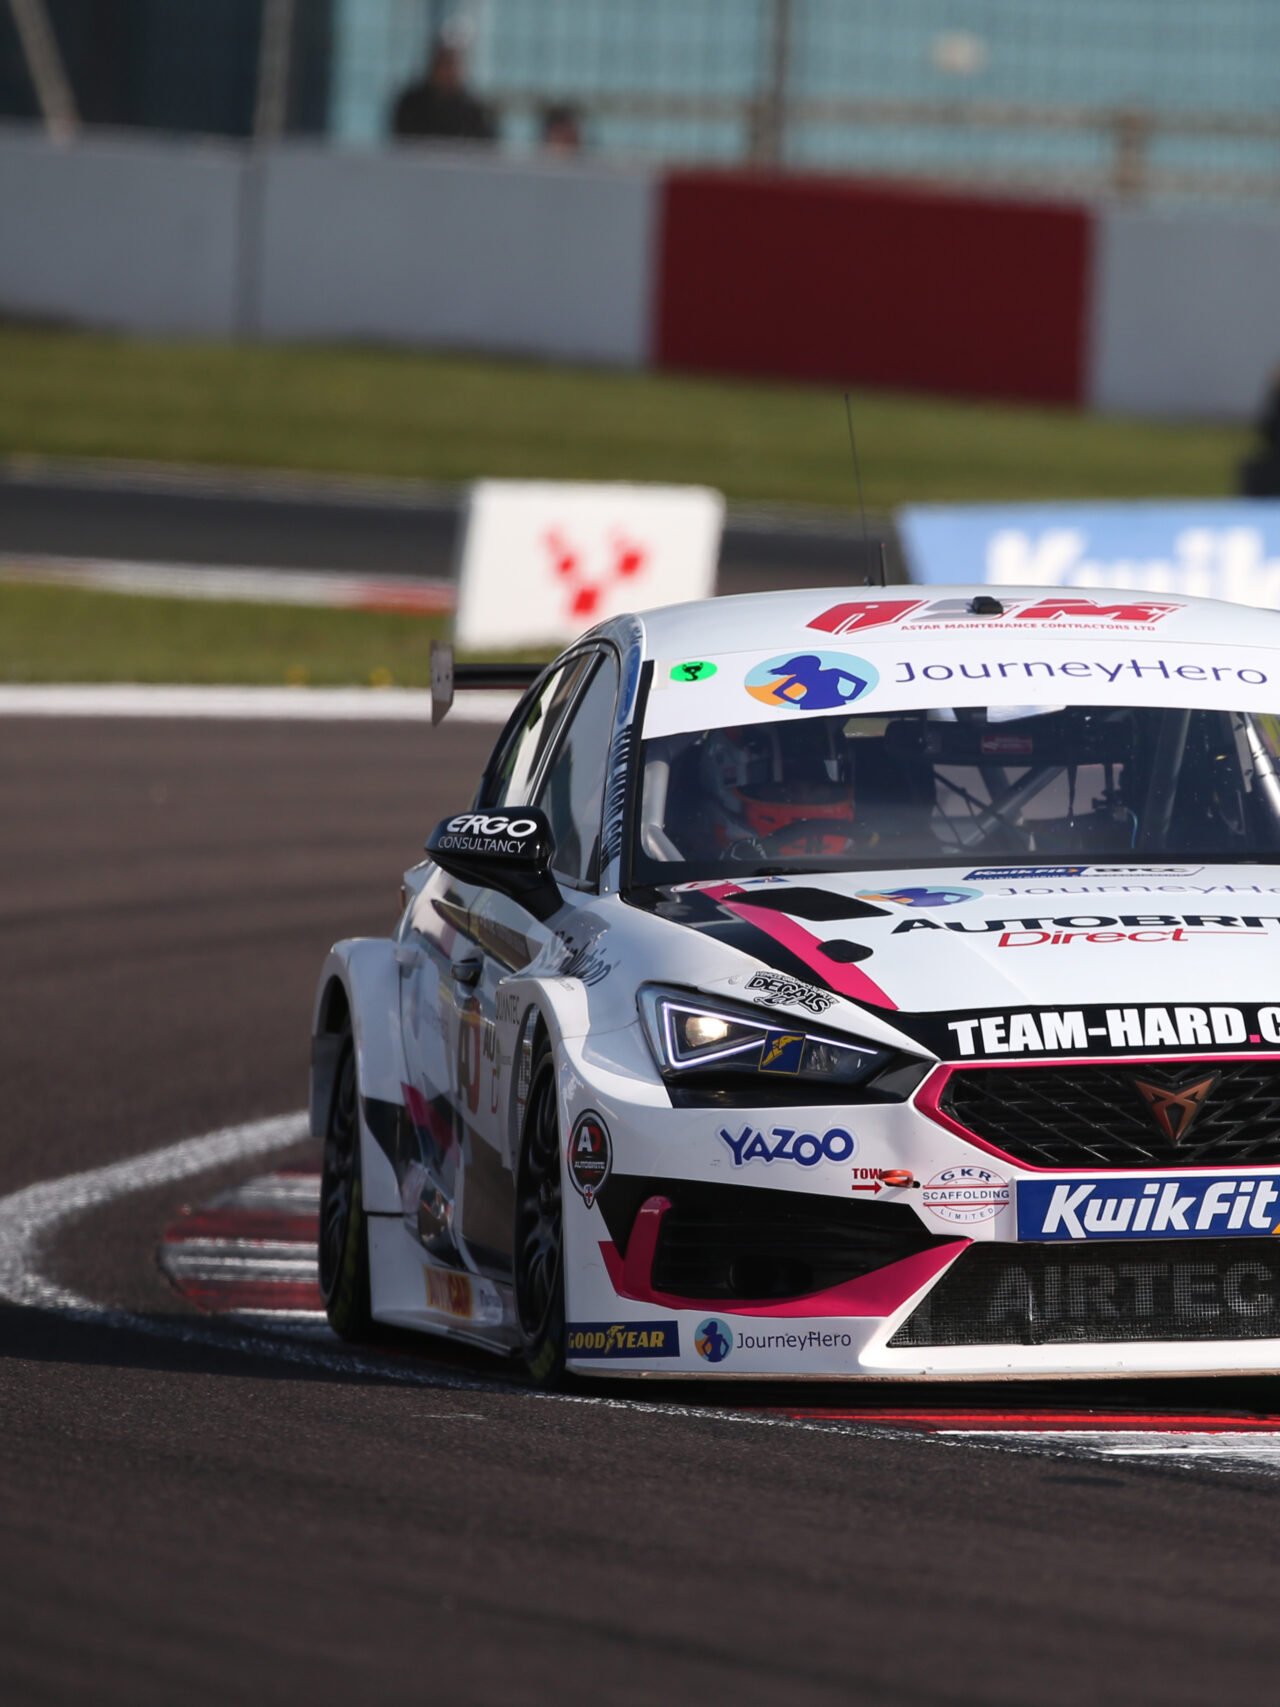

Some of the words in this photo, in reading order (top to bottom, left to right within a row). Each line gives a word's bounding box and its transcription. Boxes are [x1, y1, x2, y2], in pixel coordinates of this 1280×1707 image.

[945, 622, 1037, 630] MAINTENANCE
[1041, 623, 1130, 631] CONTRACTORS
[895, 659, 1268, 685] JourneyHero
[446, 814, 538, 838] ERGO
[438, 836, 526, 854] CONSULTANCY
[998, 928, 1188, 948] Direct
[746, 975, 832, 1014] DECALS
[719, 1126, 854, 1166] YAZOO
[941, 1168, 992, 1181] GKR
[923, 1189, 1010, 1200] SCAFFOLDING
[940, 1208, 995, 1221] LIMITED
[985, 1262, 1275, 1323] AIRTEC
[737, 1331, 852, 1351] JourneyHero
